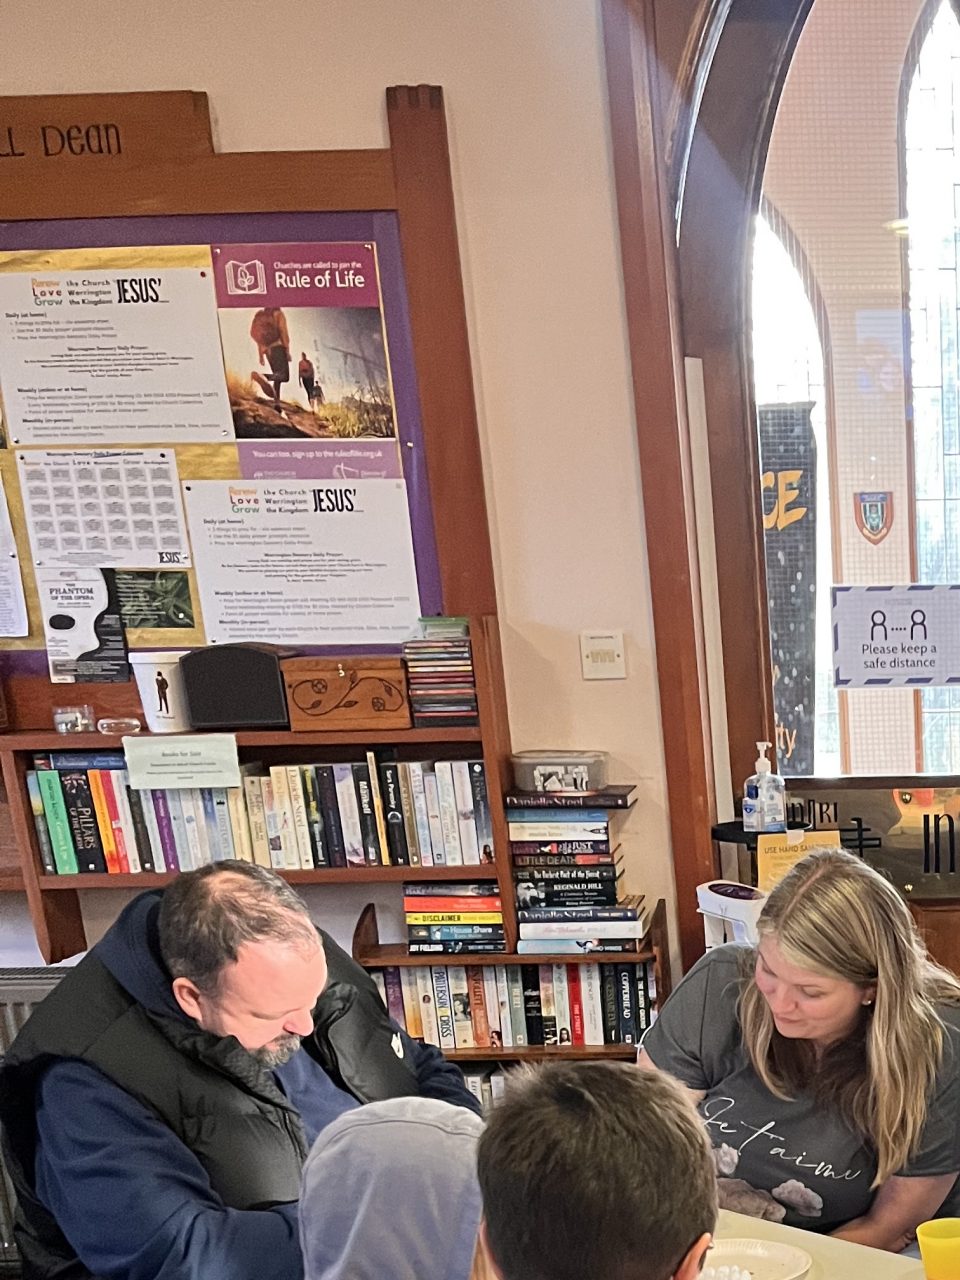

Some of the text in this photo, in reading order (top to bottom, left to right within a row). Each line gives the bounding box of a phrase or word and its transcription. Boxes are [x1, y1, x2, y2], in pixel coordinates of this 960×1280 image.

[81, 279, 111, 287] Church
[275, 270, 366, 288] Rule of Life
[32, 287, 62, 297] Love
[34, 296, 63, 306] Grow
[230, 495, 260, 505] Love
[232, 504, 260, 514] Grow
[49, 587, 94, 595] PHANTOM
[861, 643, 937, 657] Please keep a
[863, 658, 936, 669] safe distance
[359, 781, 372, 814] Mankell
[293, 804, 305, 828] Steel
[764, 847, 777, 855] USE
[779, 846, 798, 854] HAND
[519, 855, 547, 865] LITTLE
[553, 883, 587, 891] REGINALD
[422, 914, 461, 922] DISCLAIMER
[564, 909, 593, 918] Steel
[621, 972, 631, 1019] COPPERHEAD
[439, 1015, 452, 1038] CROSS
